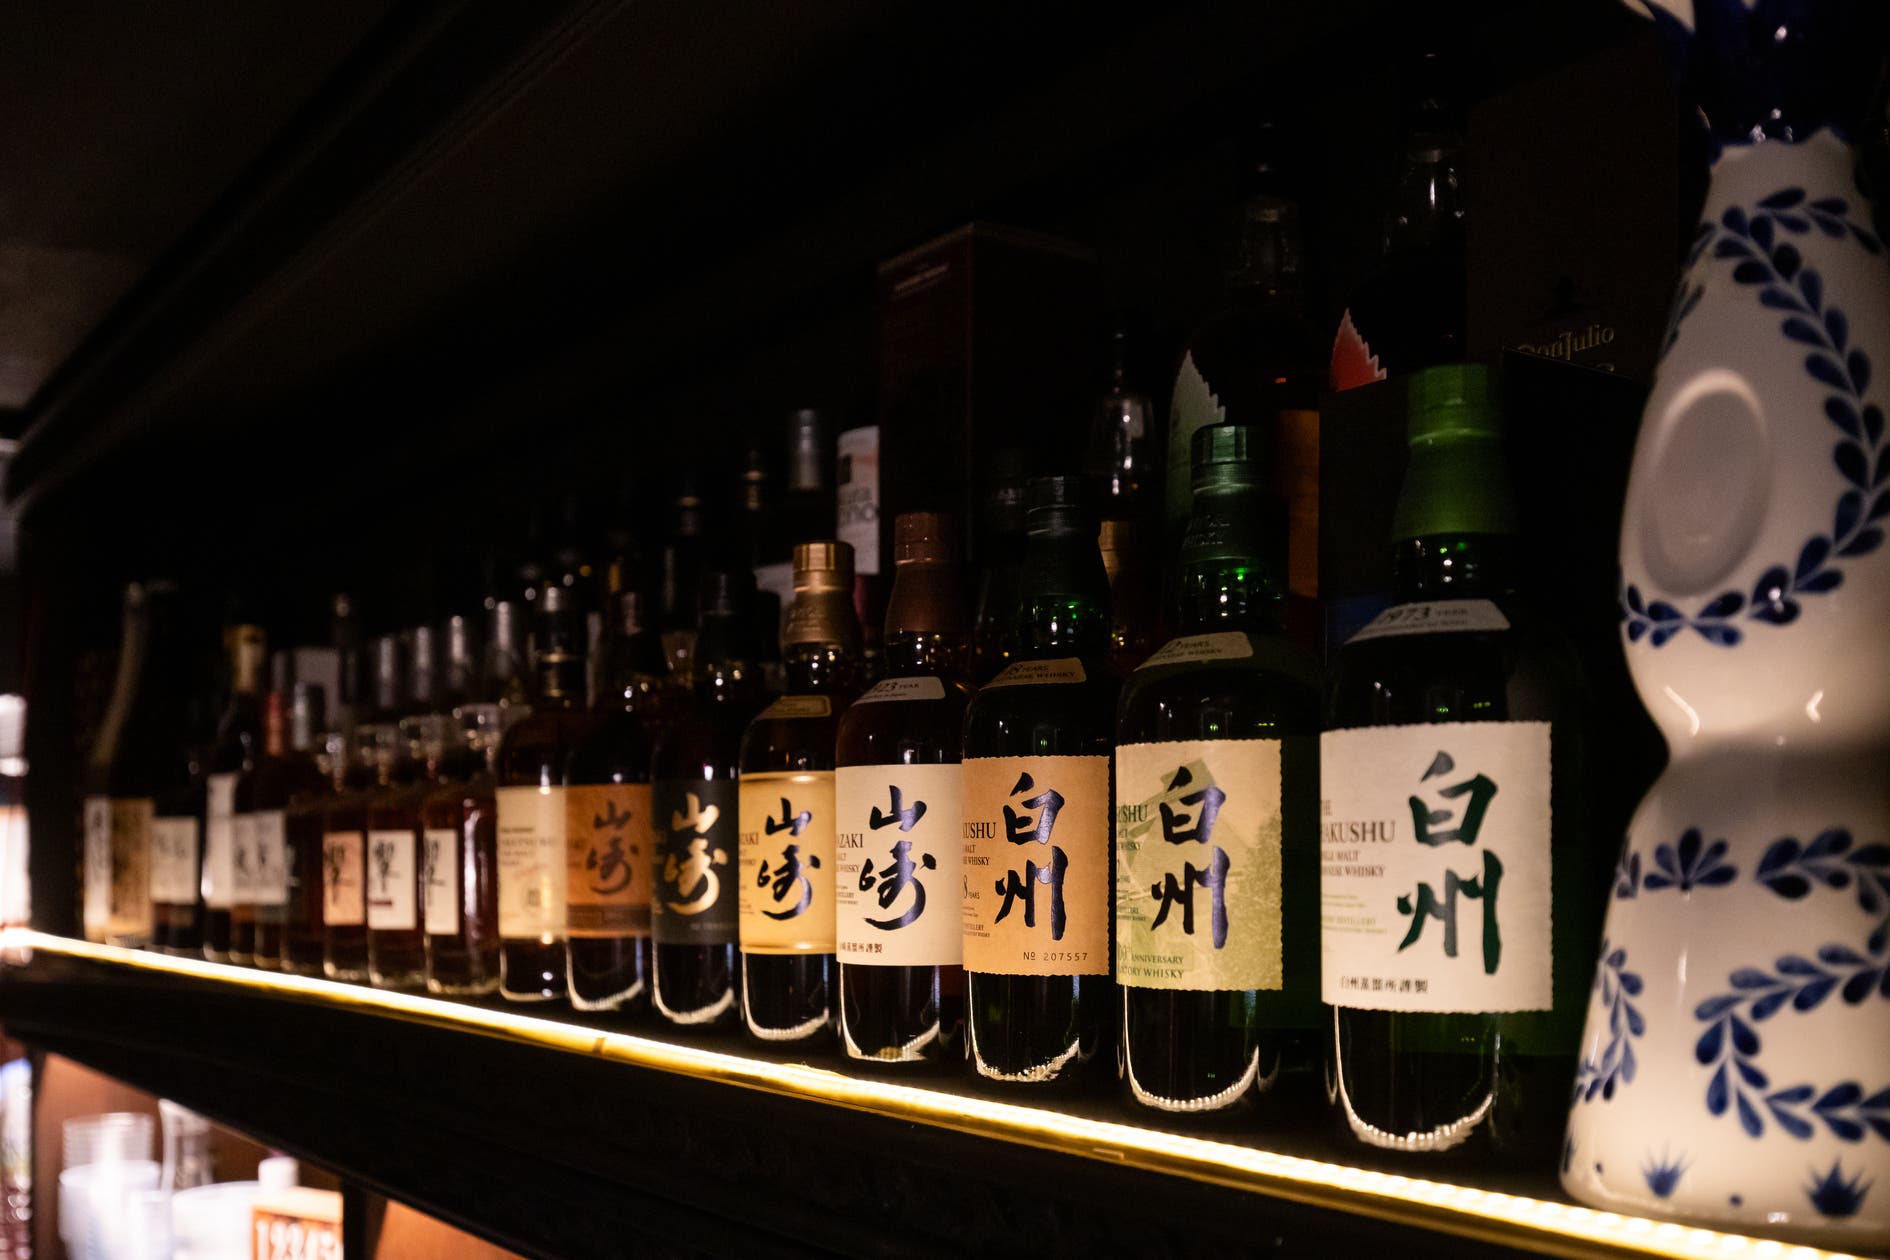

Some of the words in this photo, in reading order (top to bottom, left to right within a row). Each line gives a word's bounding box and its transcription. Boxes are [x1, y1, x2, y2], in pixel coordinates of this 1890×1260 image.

[756, 797, 821, 920] 山崎
[858, 784, 937, 931] 山崎
[994, 771, 1069, 941] 白州
[1151, 765, 1231, 950] 白州
[1345, 865, 1387, 878] WHISKY
[1397, 750, 1504, 976] 白州
[1043, 952, 1088, 961] 207557
[1143, 967, 1184, 979] WHISKY
